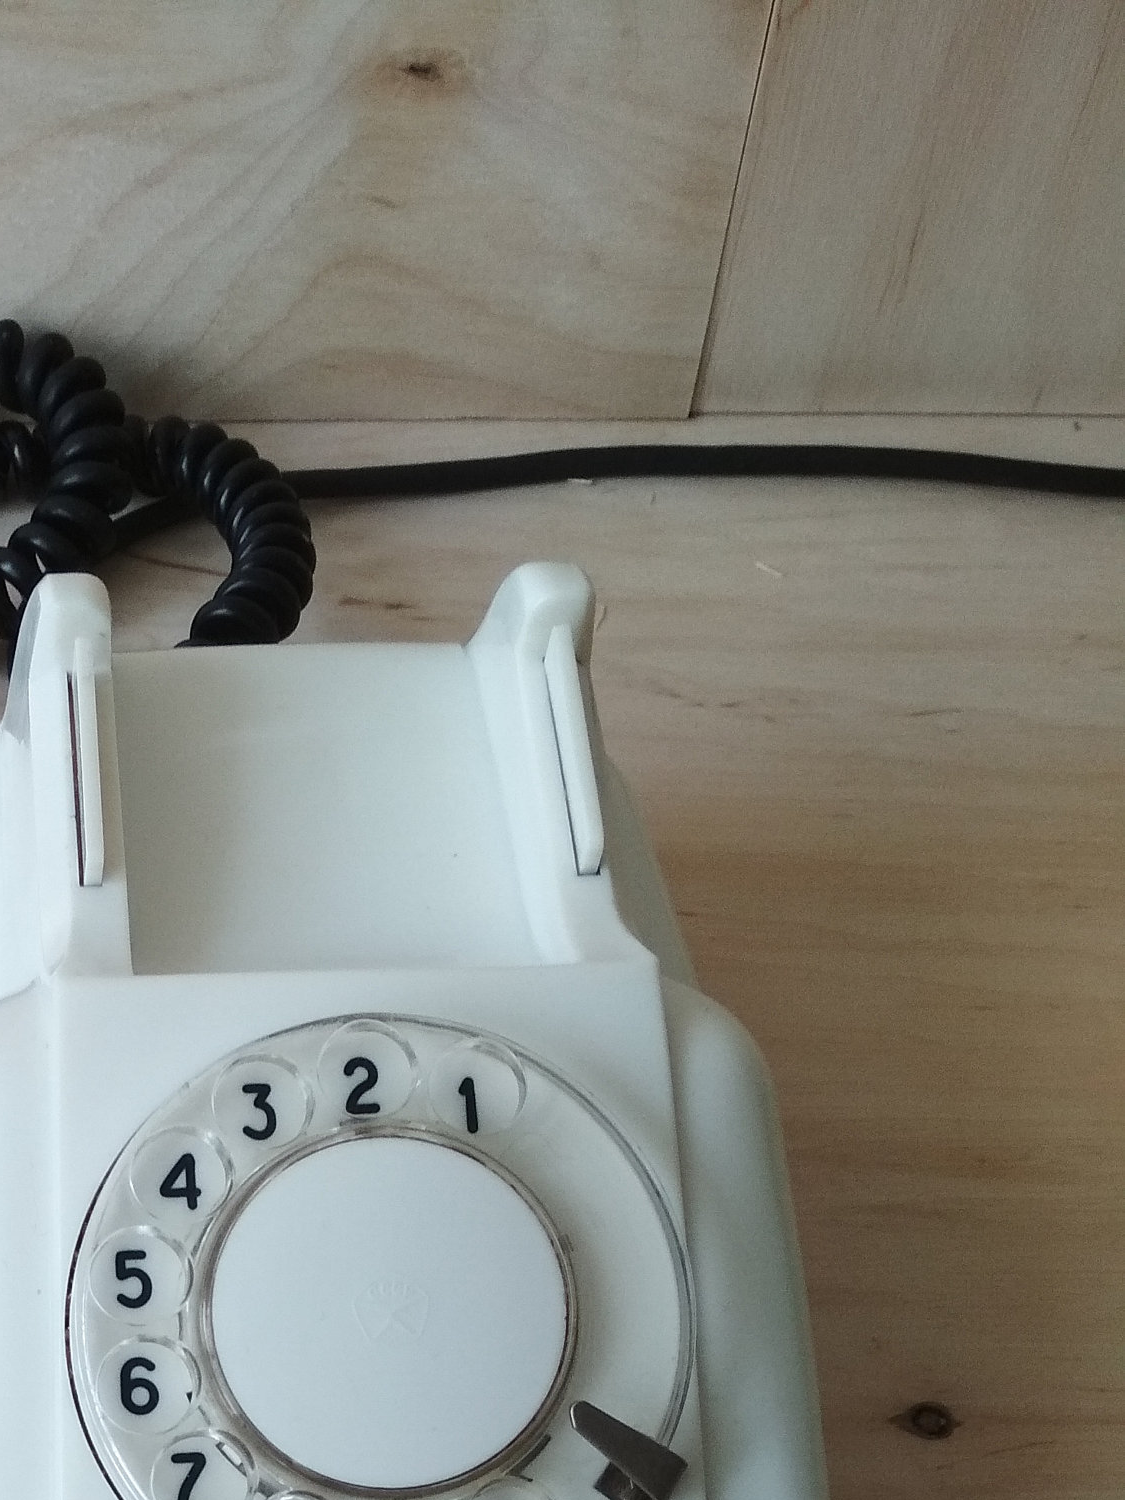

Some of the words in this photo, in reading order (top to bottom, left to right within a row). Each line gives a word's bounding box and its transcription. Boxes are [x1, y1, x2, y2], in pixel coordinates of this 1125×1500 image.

[241, 1082, 278, 1141] 3
[343, 1056, 381, 1116] 2
[457, 1076, 480, 1139] 1
[158, 1152, 202, 1211] 4
[114, 1249, 153, 1310] 5
[119, 1356, 160, 1416] 6
